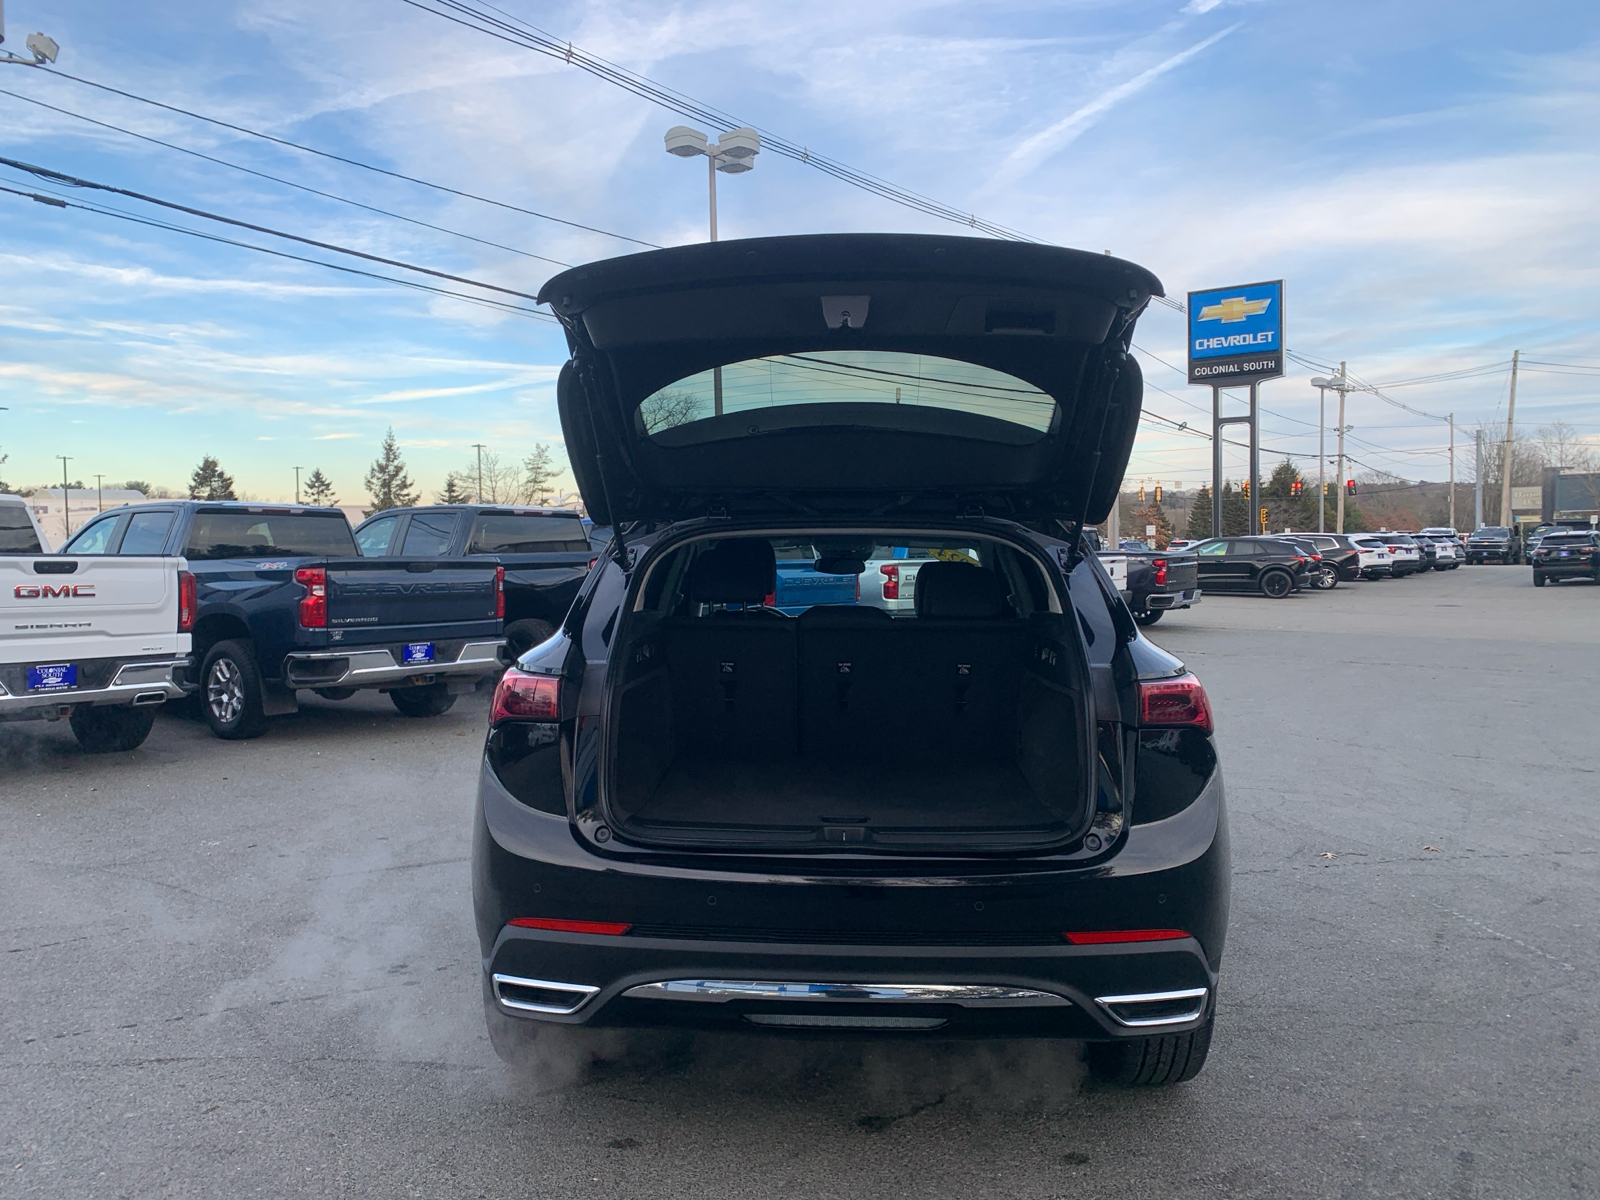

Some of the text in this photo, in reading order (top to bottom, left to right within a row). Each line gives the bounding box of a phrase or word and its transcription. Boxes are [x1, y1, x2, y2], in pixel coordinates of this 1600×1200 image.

[1195, 331, 1275, 350] CHEVROLET
[1194, 360, 1275, 376] COLONIAL SOUTH
[784, 576, 856, 586] CHEVROLET
[14, 584, 96, 599] GMC
[344, 583, 490, 596] CHEVROLET
[331, 616, 379, 624] SILVERADO
[14, 622, 92, 630] SIERRA
[36, 667, 68, 675] COLONIAL
